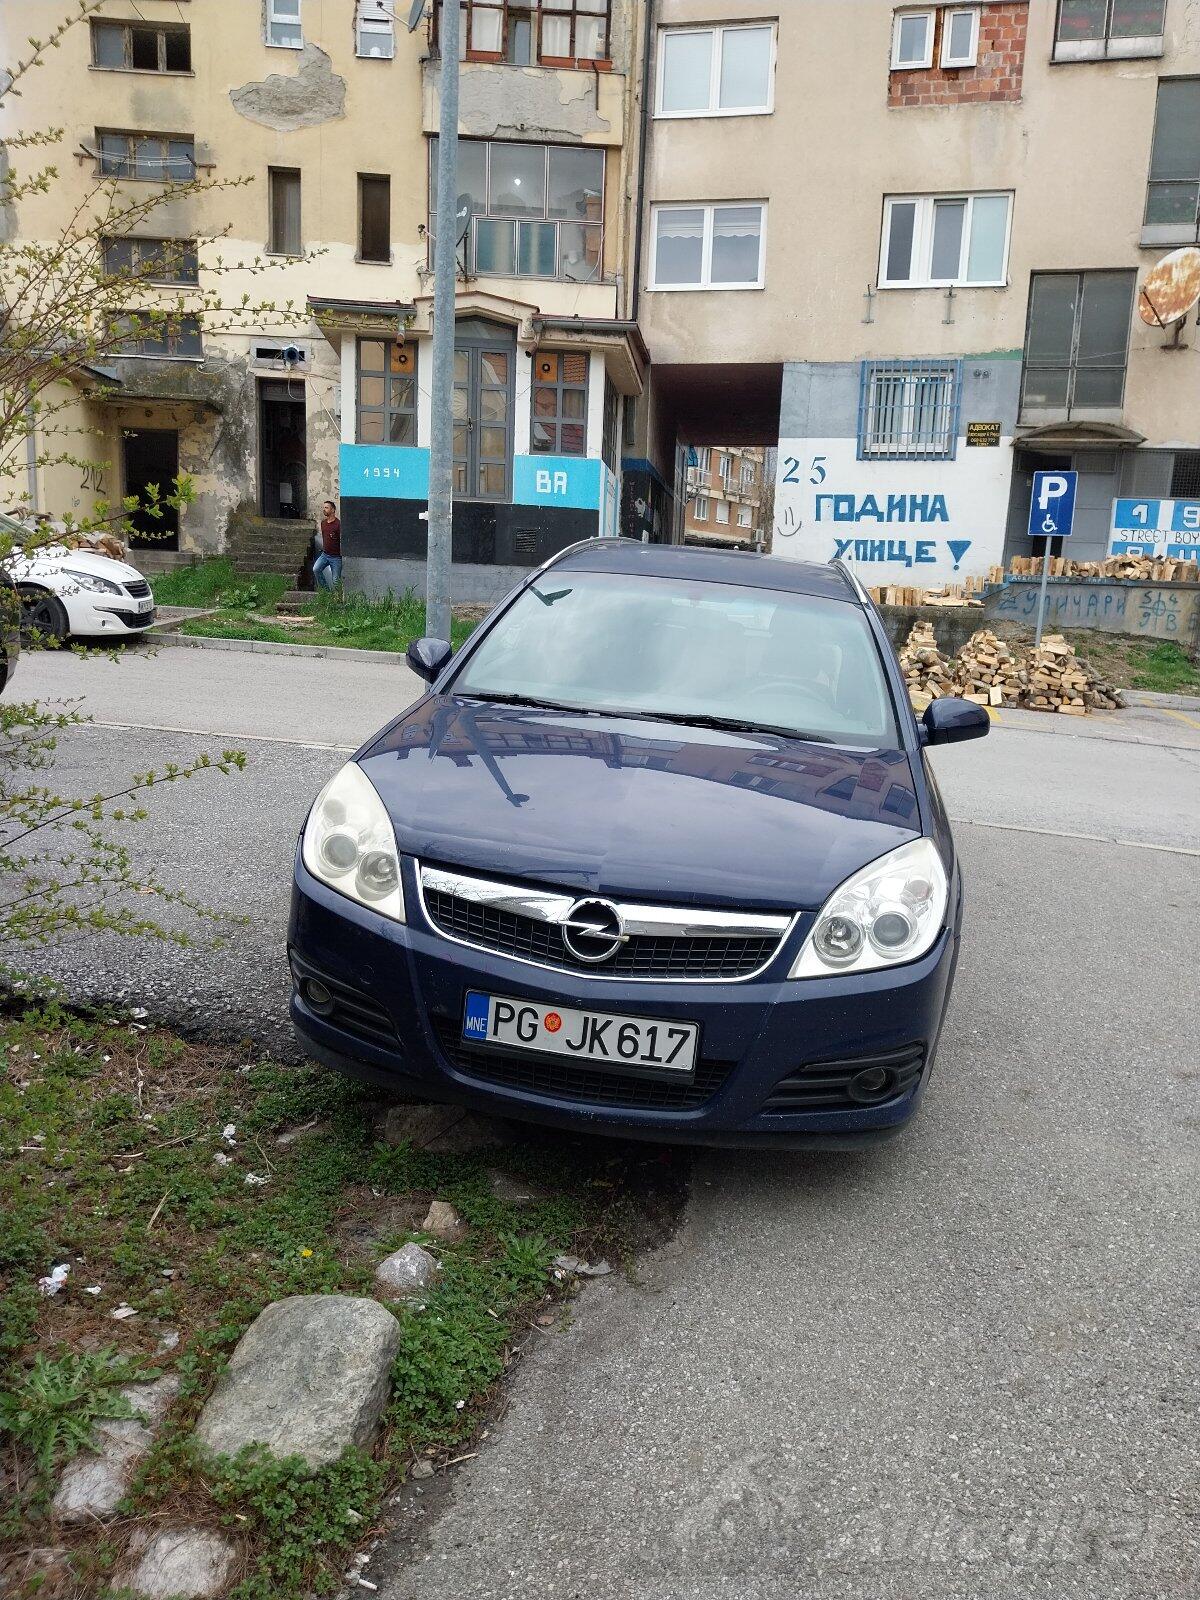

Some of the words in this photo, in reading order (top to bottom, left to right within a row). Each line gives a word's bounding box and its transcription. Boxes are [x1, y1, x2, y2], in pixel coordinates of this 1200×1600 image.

[969, 423, 1000, 432] АДВОКАТ
[363, 467, 400, 478] 1994
[1038, 476, 1068, 510] P
[815, 494, 950, 522] ГОДИНА
[1120, 529, 1168, 544] STREET
[466, 1015, 488, 1033] MNE
[493, 1001, 539, 1042] PG
[565, 1015, 691, 1064] JK617
